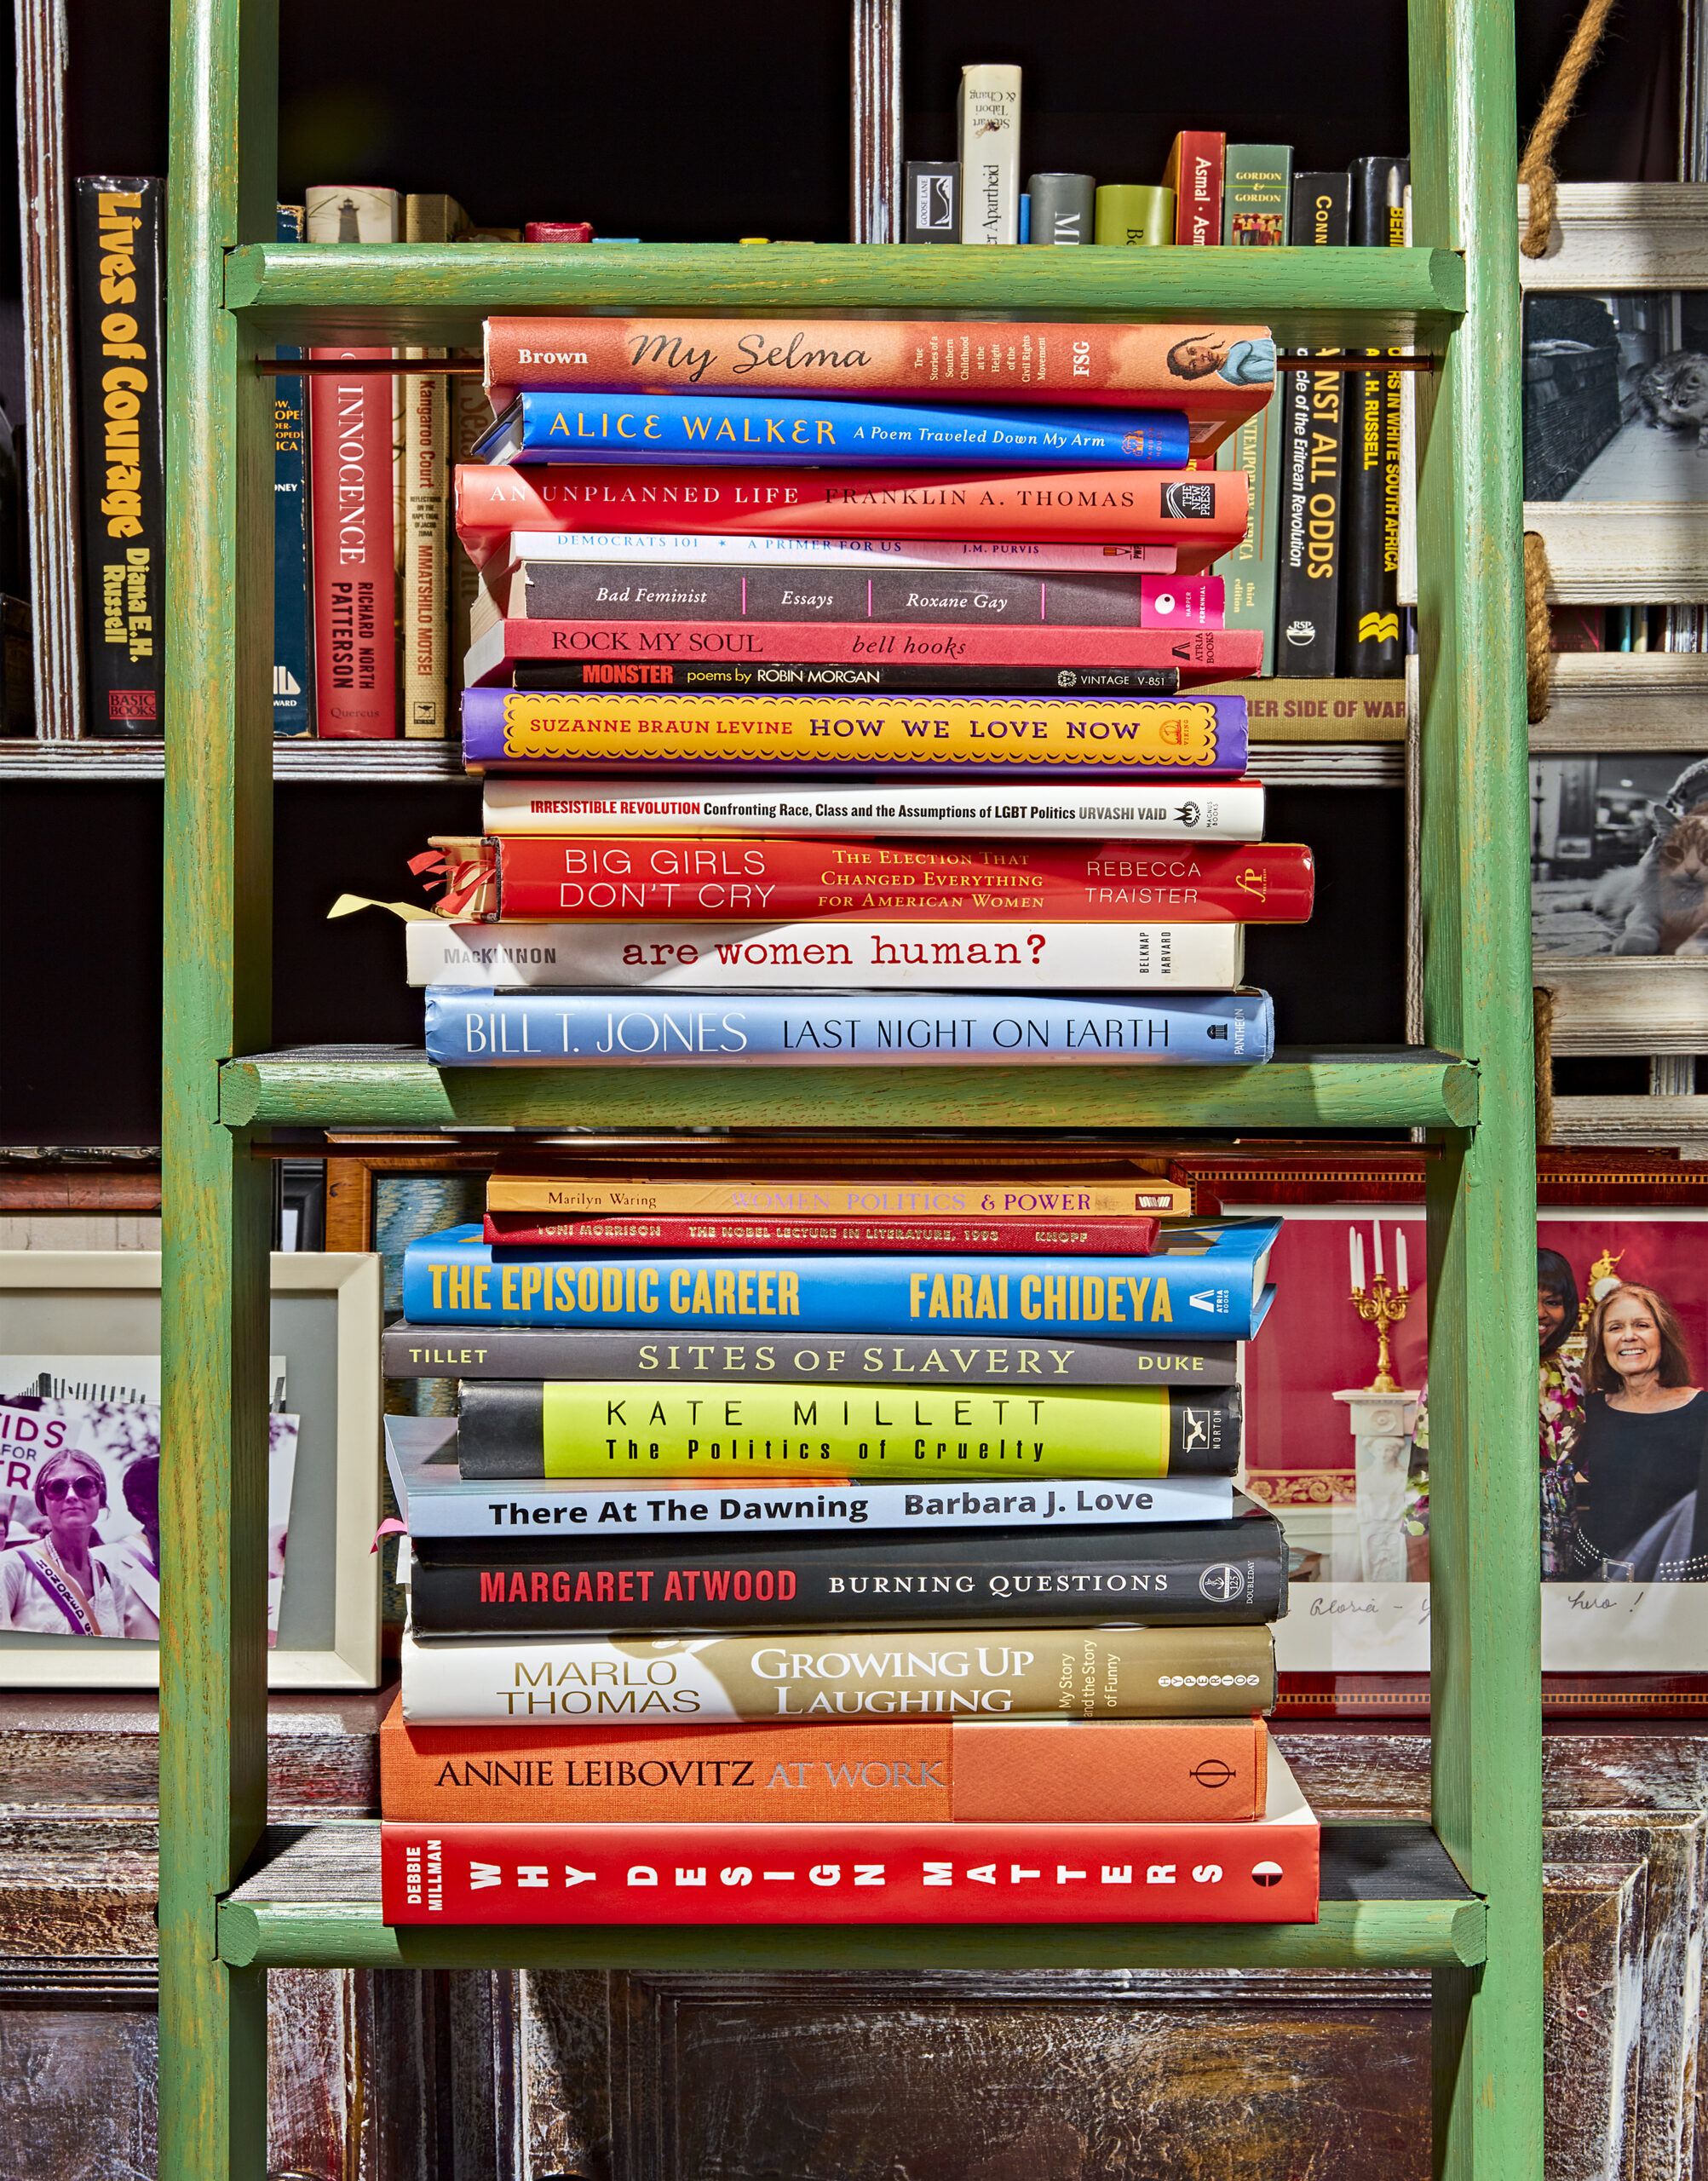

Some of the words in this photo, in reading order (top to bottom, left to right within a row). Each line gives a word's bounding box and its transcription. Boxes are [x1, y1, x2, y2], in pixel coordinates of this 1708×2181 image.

[969, 89, 1003, 101] Chang
[975, 105, 1009, 115] Tabori
[1194, 157, 1212, 201] Asmal
[1236, 172, 1281, 181] GORDON
[982, 164, 999, 231] Apartheid
[1235, 193, 1280, 203] GORDON
[98, 193, 142, 304] Lives
[101, 313, 147, 360] of
[518, 348, 588, 365] Brown
[629, 334, 717, 382] My
[733, 331, 871, 374] Selma
[915, 348, 923, 368] True
[929, 357, 938, 381] Stories
[946, 339, 954, 377] Southern
[960, 337, 969, 380] Childhood
[992, 344, 1002, 372] Height
[1038, 337, 1046, 380] Movement
[1073, 341, 1090, 377] FSG
[417, 381, 435, 446] Kangaroo
[549, 412, 662, 440] ALICE
[681, 416, 837, 446] WALKER
[101, 366, 148, 538] Courage
[871, 428, 912, 440] Poem
[918, 429, 986, 443] Traveled
[1364, 400, 1379, 470] RUSSELL
[1386, 412, 1400, 461] WHITE
[419, 451, 435, 488] Court
[1292, 439, 1308, 492] Eritrean
[1311, 432, 1337, 483] ALL
[338, 386, 366, 565] INNOCENCE
[1385, 464, 1400, 515] SOUTH
[543, 486, 720, 504] UNPLANNED
[825, 488, 966, 506] FRANKLIN
[1018, 492, 1135, 507] THOMAS
[1182, 486, 1193, 506] THE
[1192, 485, 1201, 509] NEW
[1200, 486, 1211, 515] PRESS
[558, 534, 667, 547] DEMOCRATS
[766, 539, 831, 551] PRIMER
[992, 544, 1039, 555] PURVIS
[1289, 494, 1306, 567] Revolution
[1307, 493, 1336, 579] ODDS
[1384, 517, 1399, 573] AFRICA
[125, 548, 151, 613] Diana
[417, 545, 433, 624] MMATSHILO
[1245, 583, 1255, 607] third
[103, 565, 127, 644] Russell
[358, 582, 374, 639] RICHARD
[596, 588, 629, 602] Bad
[635, 588, 707, 603] Feminist
[782, 591, 834, 608] Essays
[906, 593, 968, 608] Roxane
[974, 595, 1008, 612] Gay
[332, 582, 354, 689] PATTERSON
[417, 627, 433, 676] MOTSEI
[552, 630, 630, 651] ROCK
[689, 633, 763, 653] SOUL
[852, 636, 894, 654] bell
[904, 636, 966, 659] hooks
[359, 647, 375, 689] NORTH
[583, 665, 673, 684] MONSTER
[757, 669, 803, 682] ROBIN
[807, 670, 880, 683] MORGAN
[1081, 676, 1129, 685] VINTAGE
[109, 705, 156, 717] BOOKS
[110, 693, 155, 706] BASIC
[331, 707, 380, 719] Quercus
[530, 718, 631, 734] SUZANNE
[638, 719, 710, 734] BRAUN
[716, 721, 792, 735] LEVINE
[809, 718, 885, 738] HOW
[970, 721, 1048, 739] LOVE
[1067, 722, 1141, 739] NOW
[531, 801, 618, 815] IRRESISTIBLE
[620, 802, 699, 815] REVOLUTION
[703, 803, 776, 819] Confronting
[899, 804, 976, 822] Assumptions
[994, 806, 1027, 820] LGBT
[1031, 806, 1076, 820] Politics
[1078, 807, 1135, 820] URVASHI
[1138, 808, 1167, 820] VAID
[651, 850, 766, 876] GIRLS
[1087, 860, 1201, 878] REBECCA
[561, 883, 680, 907] DON'T
[1084, 888, 1198, 904] TRAISTER
[715, 943, 853, 966] women
[871, 934, 1046, 965] human?
[1140, 931, 1149, 974] BELKNAP
[1161, 930, 1170, 974] HARVARD
[466, 1013, 542, 1053] BILL
[596, 1012, 748, 1053] JONES
[784, 1019, 860, 1049] LAST
[878, 1019, 975, 1048] NIGHT
[1067, 1018, 1169, 1047] EARTH
[1234, 1008, 1244, 1055] PANTHEON
[549, 1192, 602, 1208] Marilyn
[609, 1193, 658, 1210] Waring
[731, 1192, 830, 1211] WOMEN
[848, 1194, 966, 1211] POLITICS
[1004, 1194, 1090, 1210] POWER
[579, 1225, 661, 1236] MORRISON
[722, 1227, 770, 1238] NOBEL
[776, 1228, 837, 1238] LECTURE
[866, 1229, 957, 1241] LITERATURE,
[1035, 1231, 1088, 1243] KNOPF
[428, 1264, 492, 1310] THE
[502, 1266, 659, 1313] EPISODIC
[670, 1269, 800, 1315] CAREER
[910, 1273, 1009, 1320] FARAI
[1020, 1275, 1173, 1323] CHIDEYA
[1216, 1289, 1224, 1314] ATRIA
[409, 1349, 487, 1364] TILLET
[638, 1345, 775, 1371] SITES
[862, 1347, 1076, 1374] SLAVERY
[1138, 1356, 1204, 1371] DUKE
[607, 1400, 743, 1426] KATE
[794, 1400, 1045, 1426] MILLETT
[1213, 1410, 1222, 1450] NORTON
[1, 1444, 37, 1461] FOR
[688, 1439, 831, 1460] Politics
[915, 1438, 1045, 1463] Cruelty
[489, 1501, 589, 1526] There
[720, 1496, 868, 1523] Dawning
[906, 1491, 1037, 1516] Barbara
[1077, 1489, 1153, 1511] Love
[37, 1559, 84, 1620] HONORED
[480, 1571, 654, 1603] MARGARET
[664, 1570, 796, 1602] ATWOOD
[829, 1576, 975, 1594] BURNING
[989, 1574, 1168, 1598] QUESTIONS
[1246, 1560, 1255, 1604] DOUBLEDAY
[515, 1660, 677, 1687] MARLO
[1059, 1654, 1075, 1689] Story
[1082, 1640, 1097, 1675] Story
[1105, 1654, 1120, 1691] Funny
[1159, 1675, 1259, 1688] HYPERION
[496, 1689, 700, 1714] THOMAS
[434, 1760, 554, 1787] ANNIE
[566, 1760, 755, 1787] LEIBOVITZ
[825, 1761, 947, 1787] WORK
[406, 1847, 422, 1905] DEBBIE
[427, 1840, 442, 1911] MILLMAN
[470, 1861, 596, 1890] WHY
[627, 1864, 885, 1887] DESIGN
[923, 1862, 1222, 1886] MATTERS
